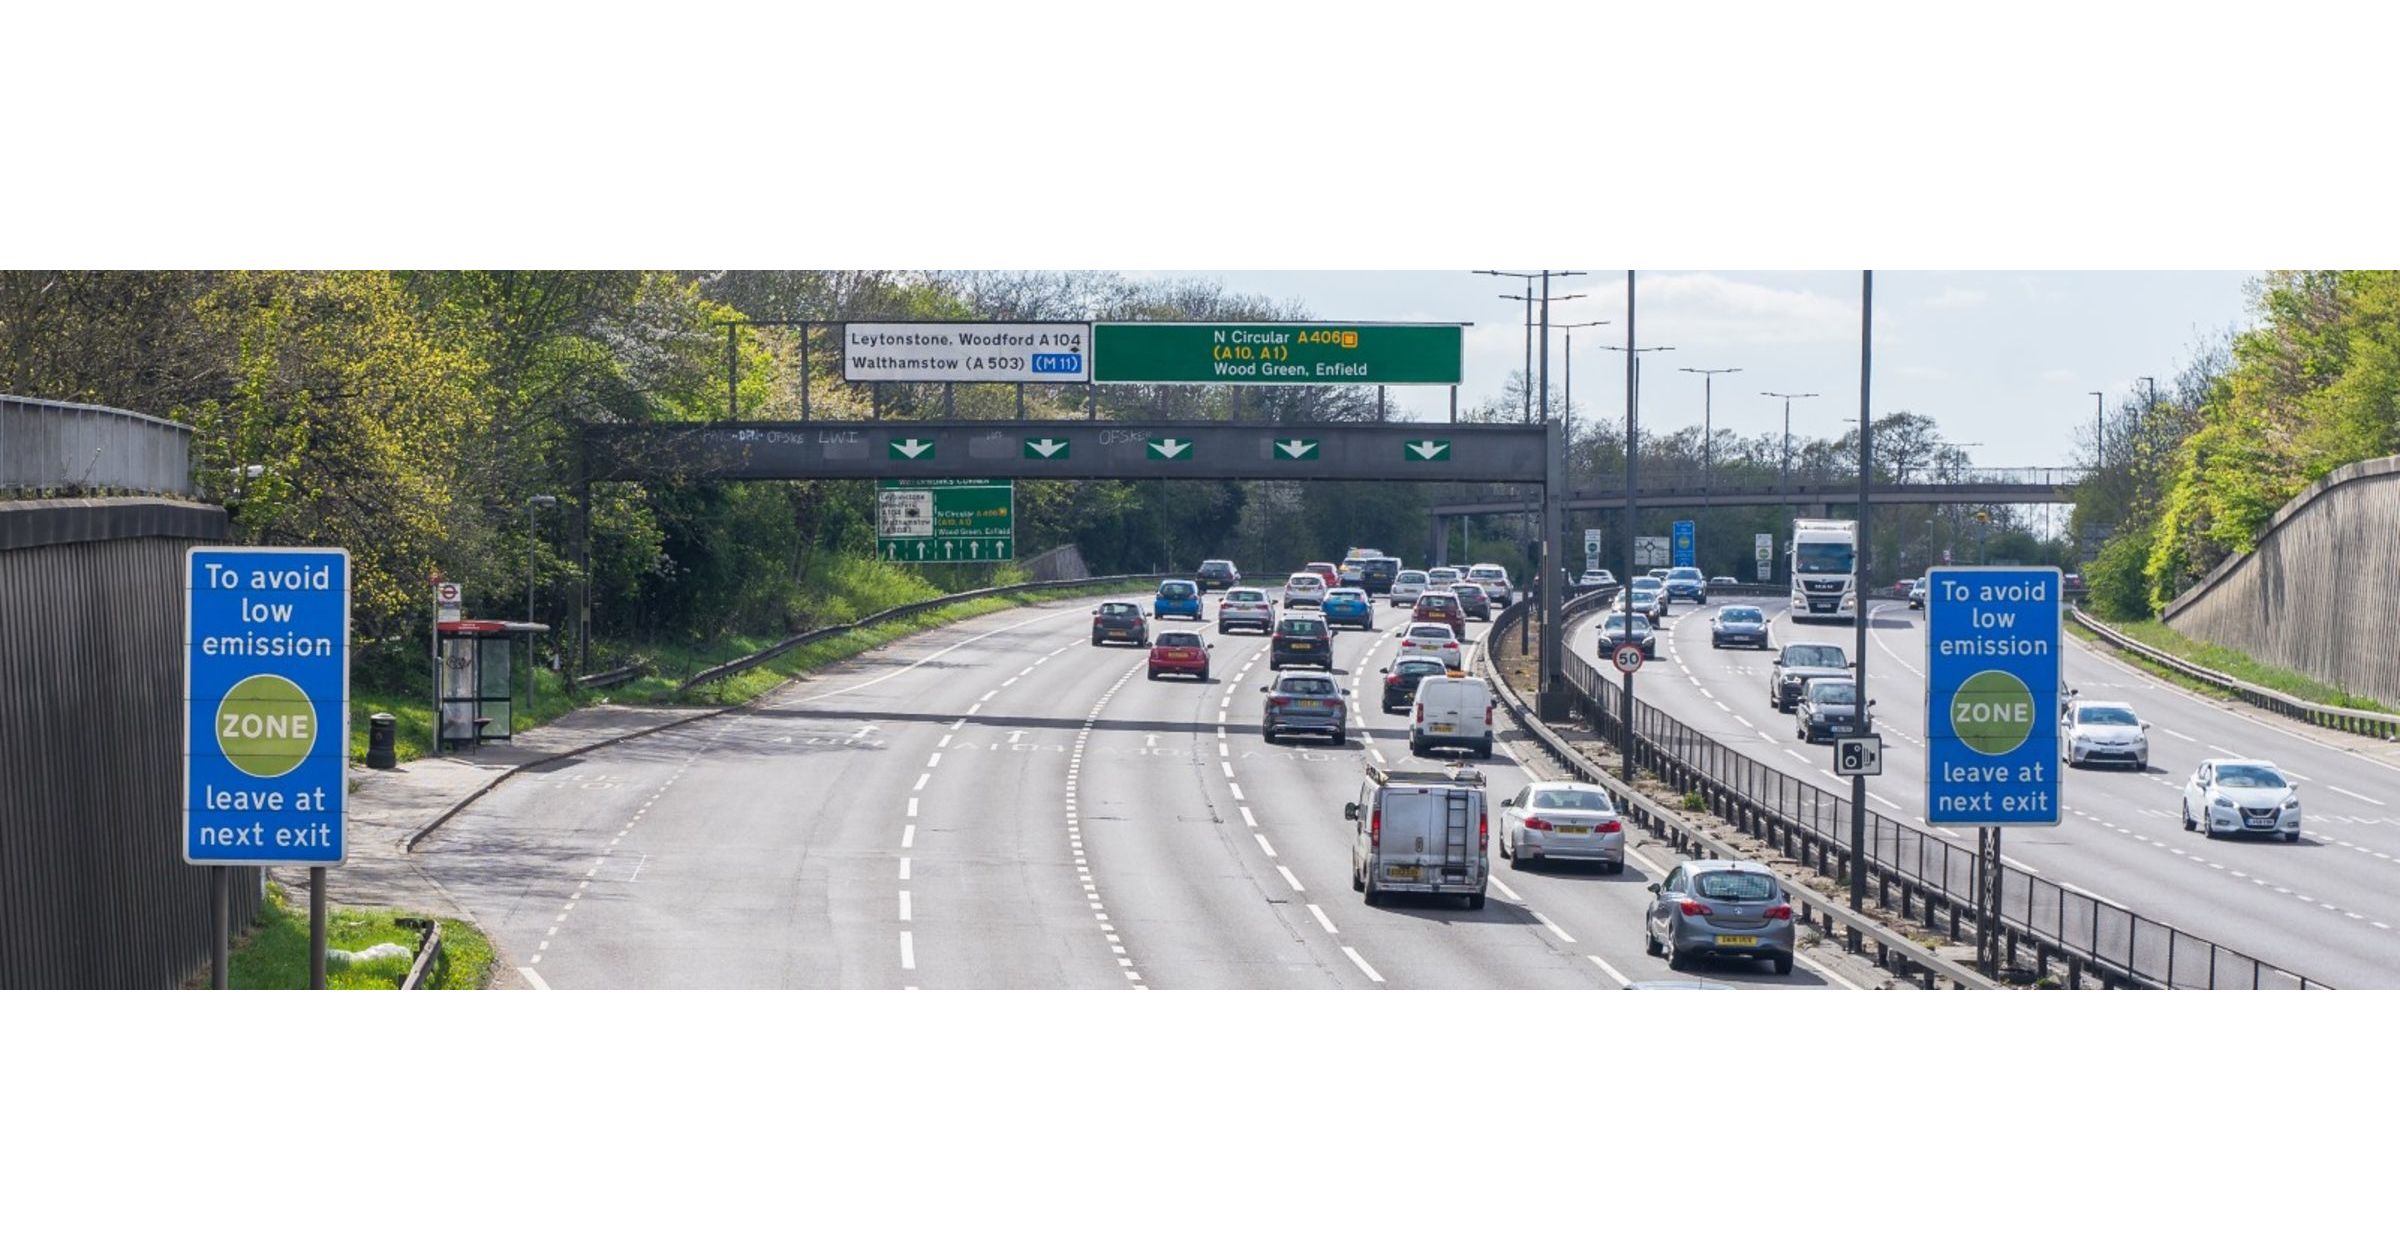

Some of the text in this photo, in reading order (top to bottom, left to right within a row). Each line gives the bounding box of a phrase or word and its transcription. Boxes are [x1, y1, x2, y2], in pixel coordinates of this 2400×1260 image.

[959, 333, 1034, 346] Woodford
[1214, 331, 1226, 344] N
[1231, 330, 1290, 344] Circular
[852, 356, 958, 370] Walthamstow
[1214, 362, 1368, 377] Wood Green, Enfield
[204, 563, 329, 590] To avoid
[1941, 581, 2046, 601] To avoid
[242, 598, 293, 623] low
[1972, 607, 2016, 628] low
[202, 632, 331, 656] emission
[1940, 635, 2048, 656] emission
[1619, 652, 1640, 665] 50
[1956, 702, 2029, 723] ZONE
[222, 714, 309, 739] ZONE
[1943, 761, 2044, 783] leave at
[206, 785, 325, 811] leave at
[1939, 791, 2048, 811] next exit
[200, 822, 331, 848] next exit
